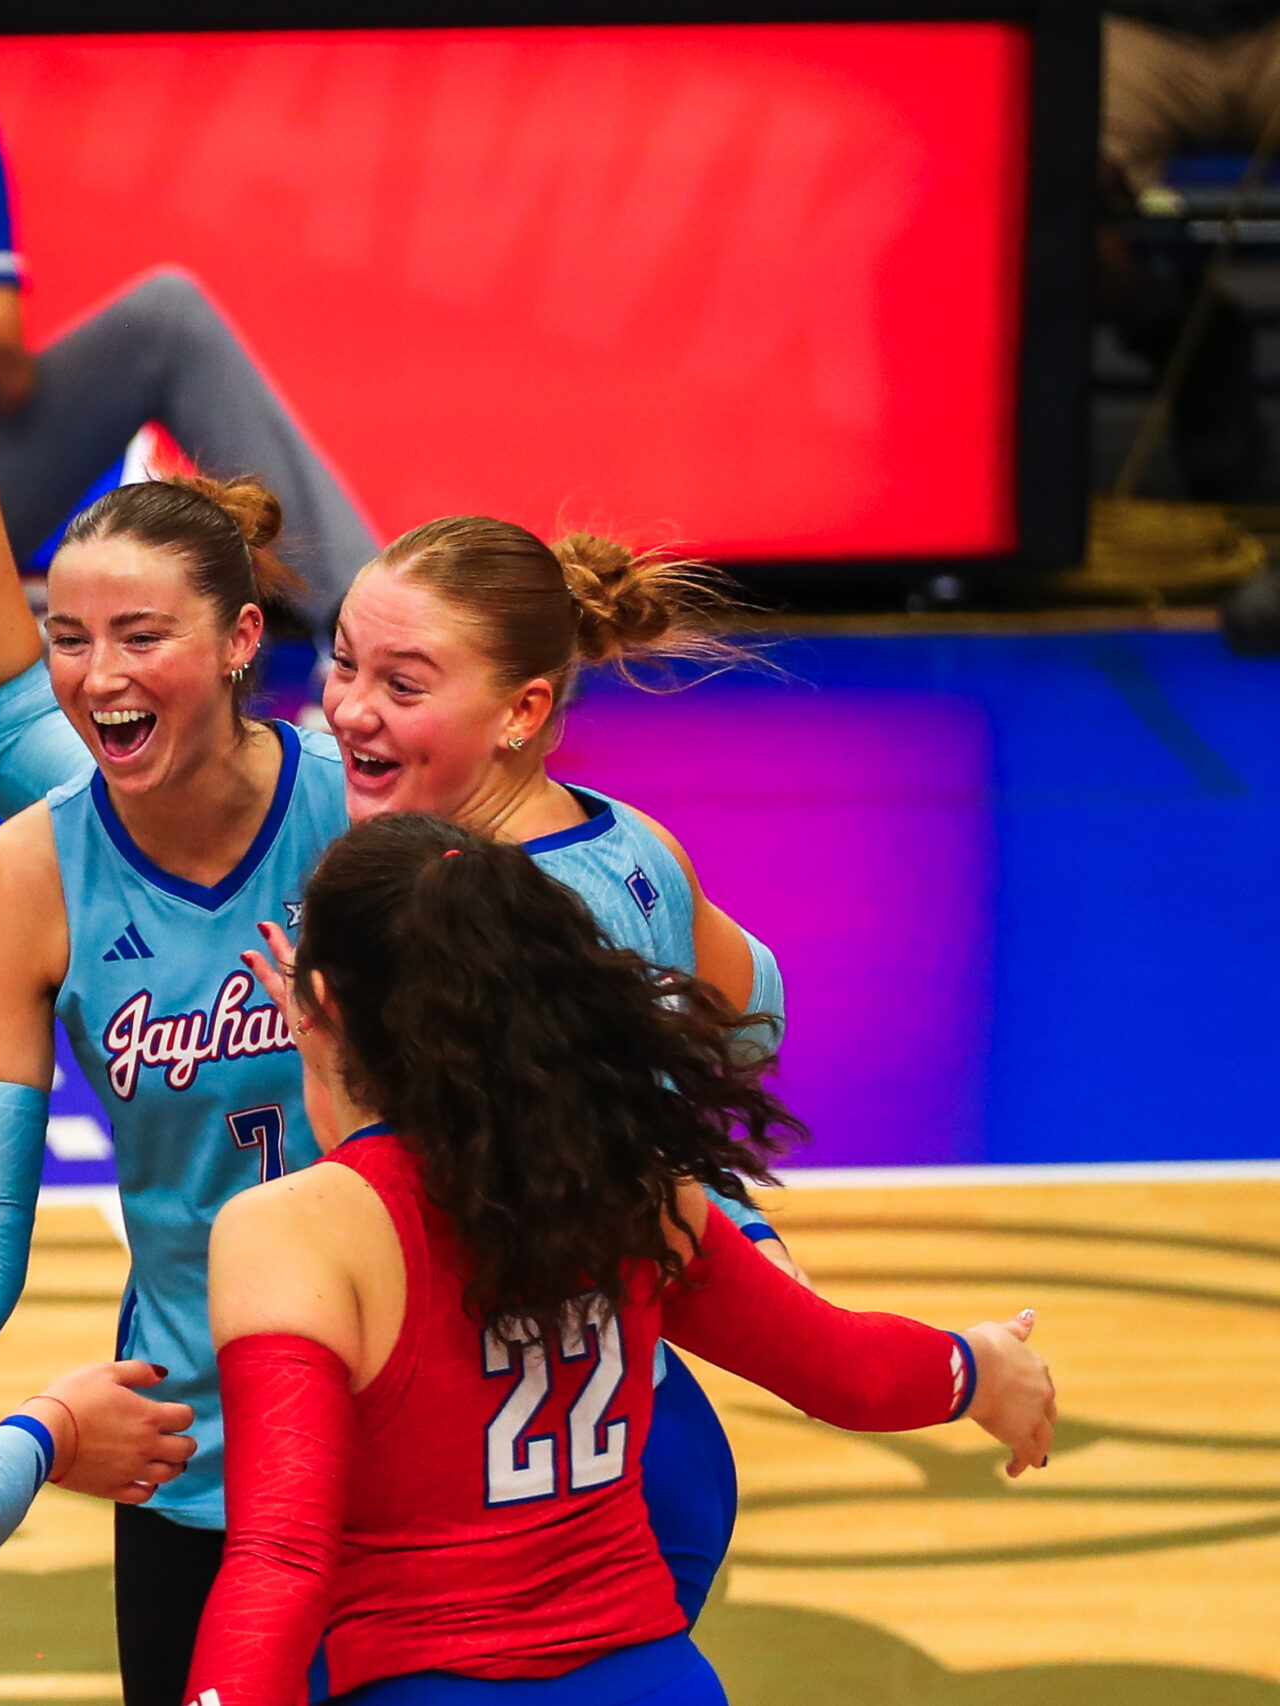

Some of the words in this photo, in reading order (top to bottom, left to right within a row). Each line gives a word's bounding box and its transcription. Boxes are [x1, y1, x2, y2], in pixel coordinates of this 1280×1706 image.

[102, 969, 299, 1102] Jayha
[226, 1104, 287, 1184] 7
[481, 1286, 629, 1509] 22
